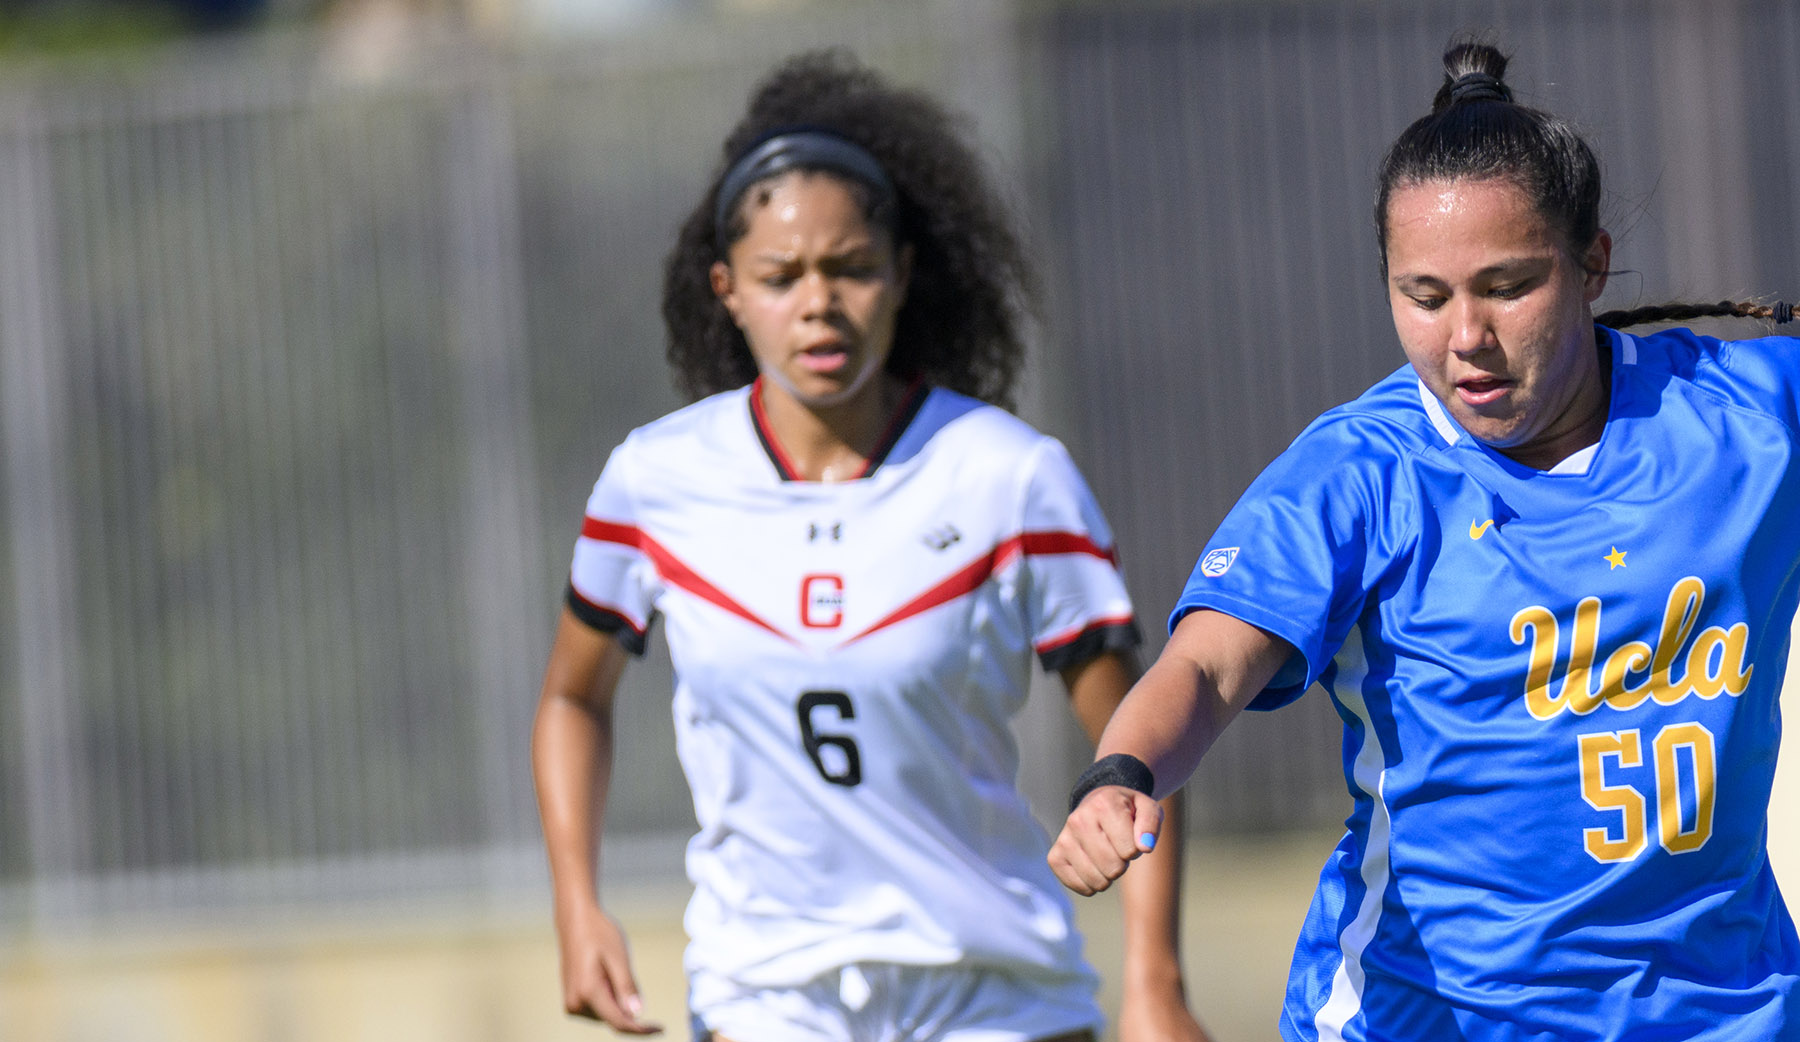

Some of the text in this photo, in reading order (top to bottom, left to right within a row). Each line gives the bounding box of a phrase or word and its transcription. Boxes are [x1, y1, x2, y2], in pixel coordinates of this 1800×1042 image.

[1205, 561, 1226, 574] 12
[796, 690, 862, 788] 6
[1577, 721, 1716, 864] 50
